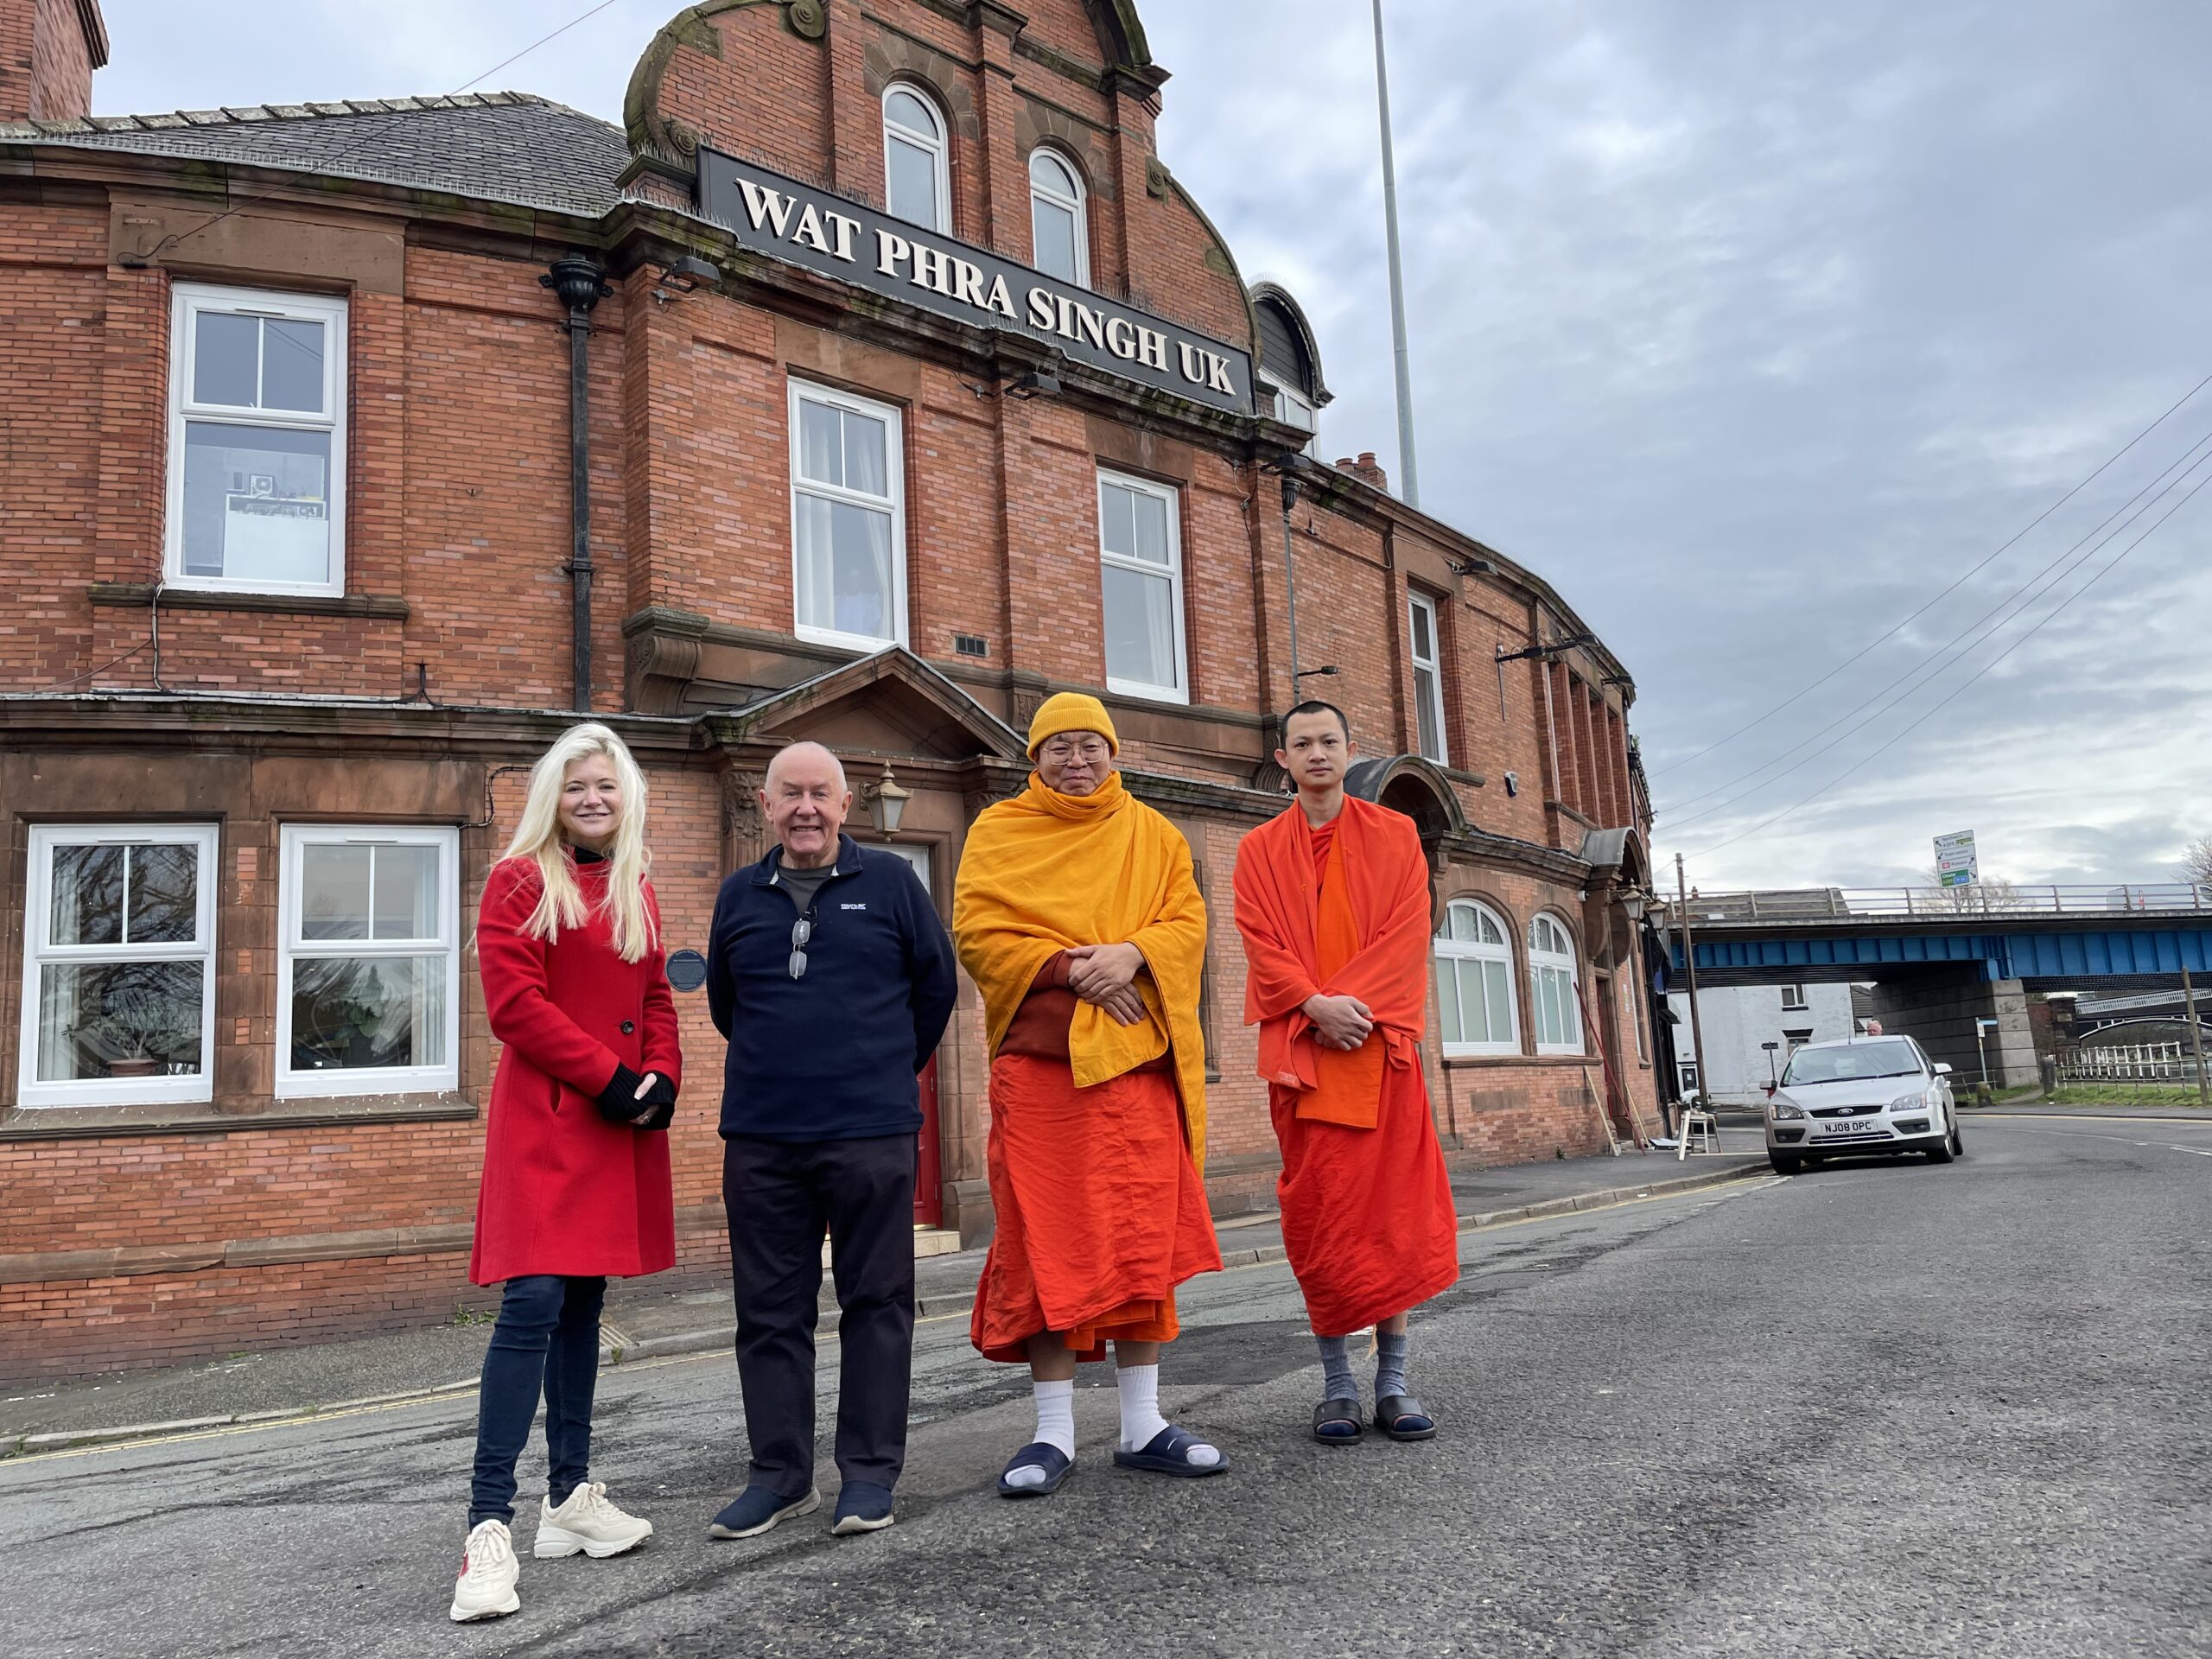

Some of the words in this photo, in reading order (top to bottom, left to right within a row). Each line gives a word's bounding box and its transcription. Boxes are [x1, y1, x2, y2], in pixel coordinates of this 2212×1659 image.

[735, 177, 861, 263] WAT
[874, 227, 1018, 319] PHRA
[1027, 287, 1170, 372] SINGH
[1177, 344, 1237, 397] UK
[1825, 1123, 1850, 1133] NJ08
